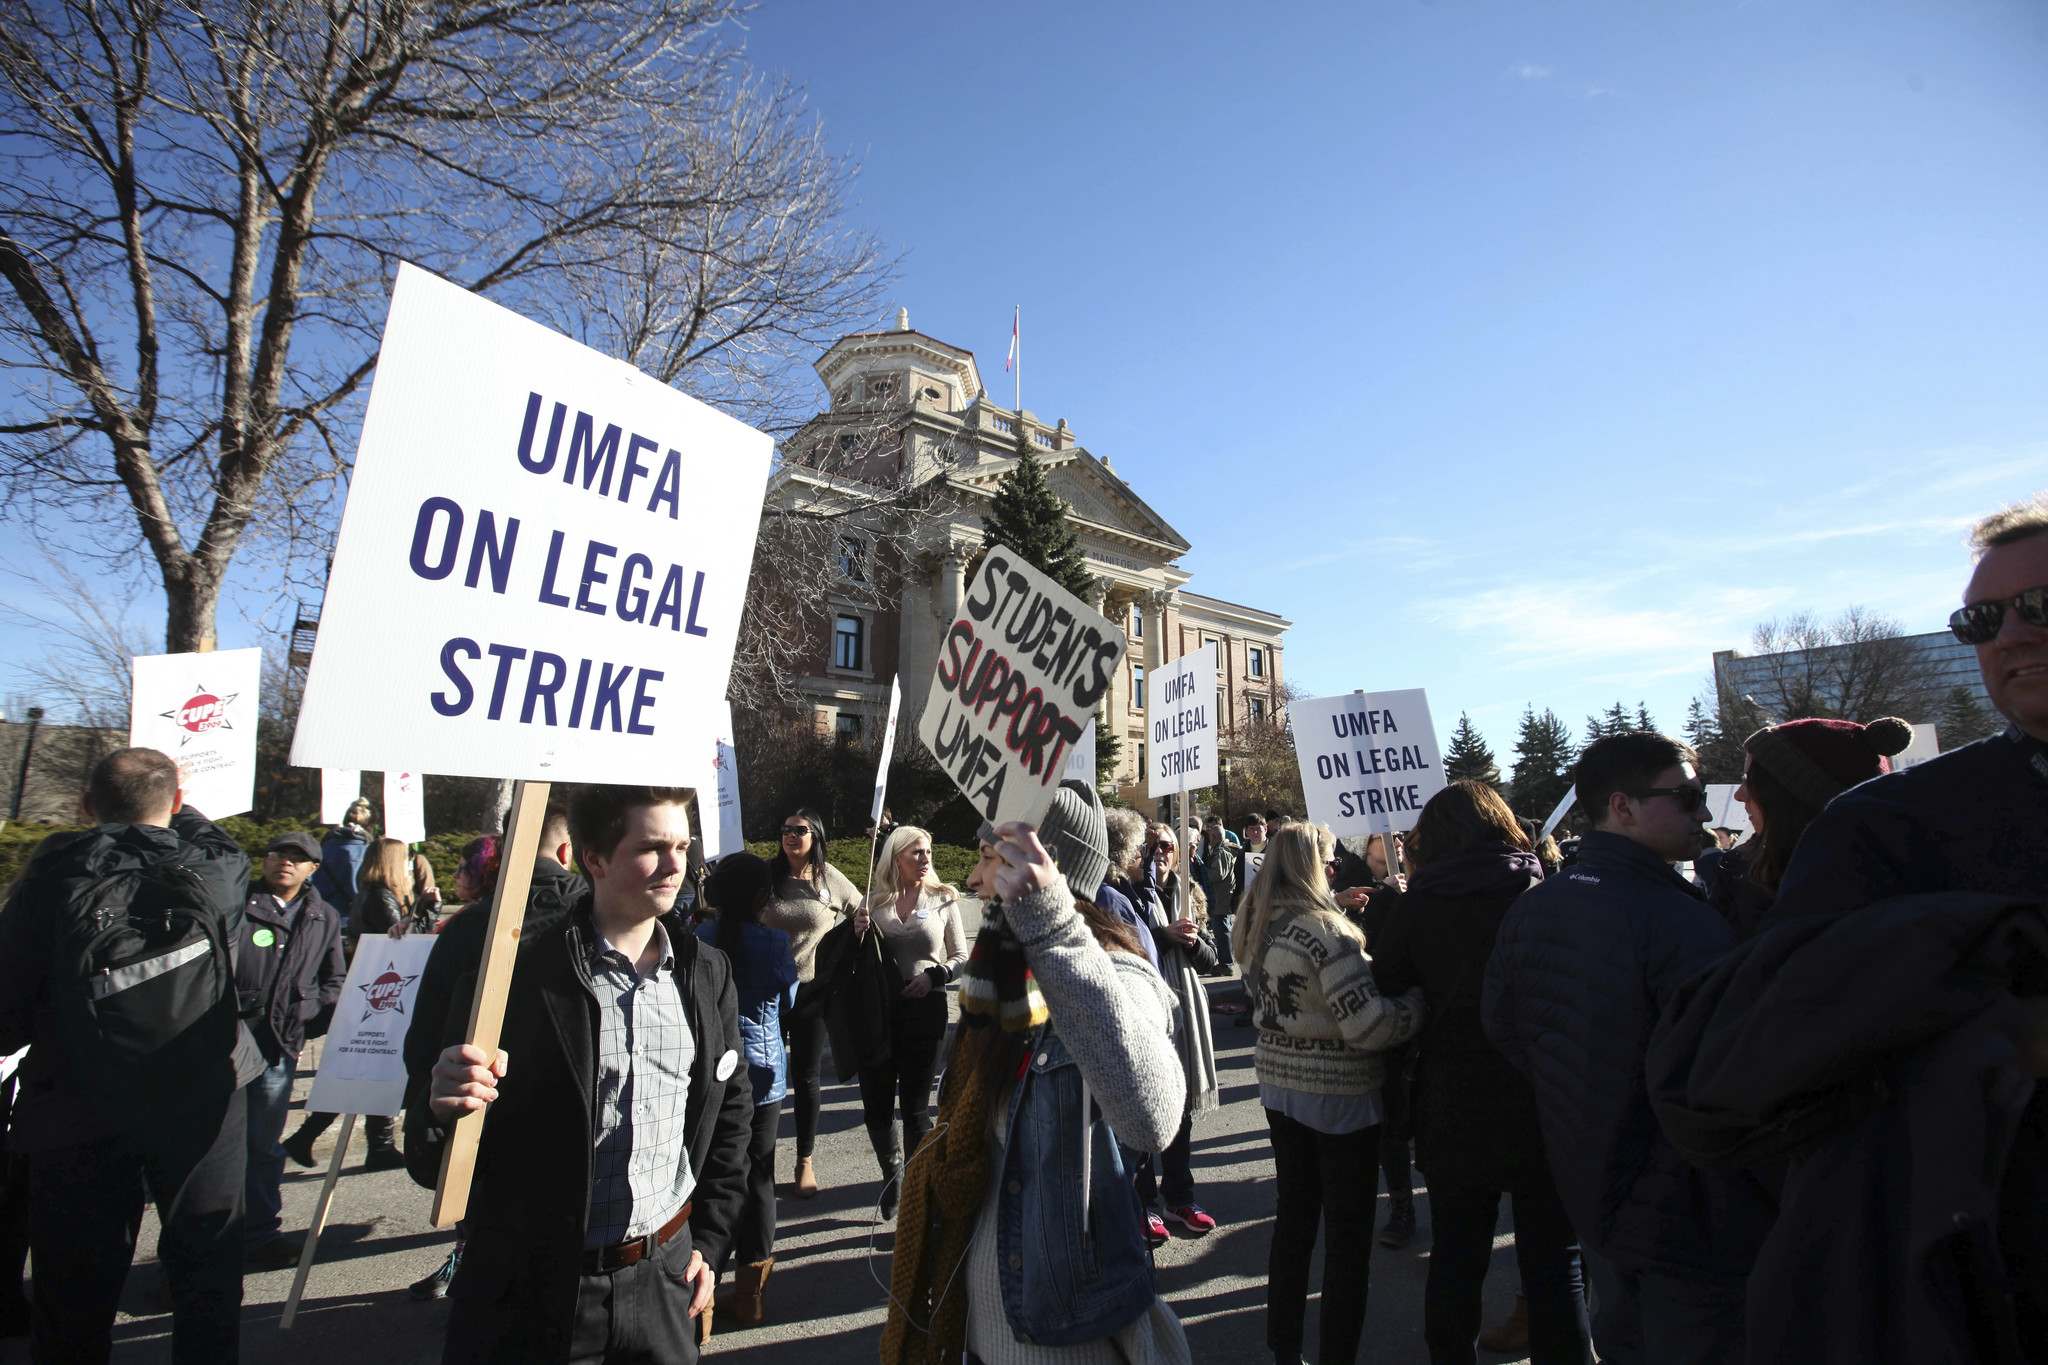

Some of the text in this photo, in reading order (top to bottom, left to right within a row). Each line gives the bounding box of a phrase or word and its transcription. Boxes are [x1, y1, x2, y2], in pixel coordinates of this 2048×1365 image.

[518, 392, 682, 519] UMFA
[410, 497, 707, 638] ON LEGAL
[967, 557, 1118, 708] STUDENTS
[431, 638, 664, 735] STRIKE
[938, 620, 1083, 786] SUPPORT
[1164, 671, 1195, 704] UMFA
[176, 700, 225, 726] CUPE
[1155, 704, 1208, 743] ON LEGAL
[1332, 709, 1398, 739] UMFA
[935, 698, 1008, 821] UMFA
[1161, 745, 1200, 778] STRIKE
[1316, 745, 1429, 780] ON LEGAL
[1338, 785, 1423, 818] STRIKE
[1574, 873, 1601, 883] Columbia
[366, 981, 405, 1000] CUPE
